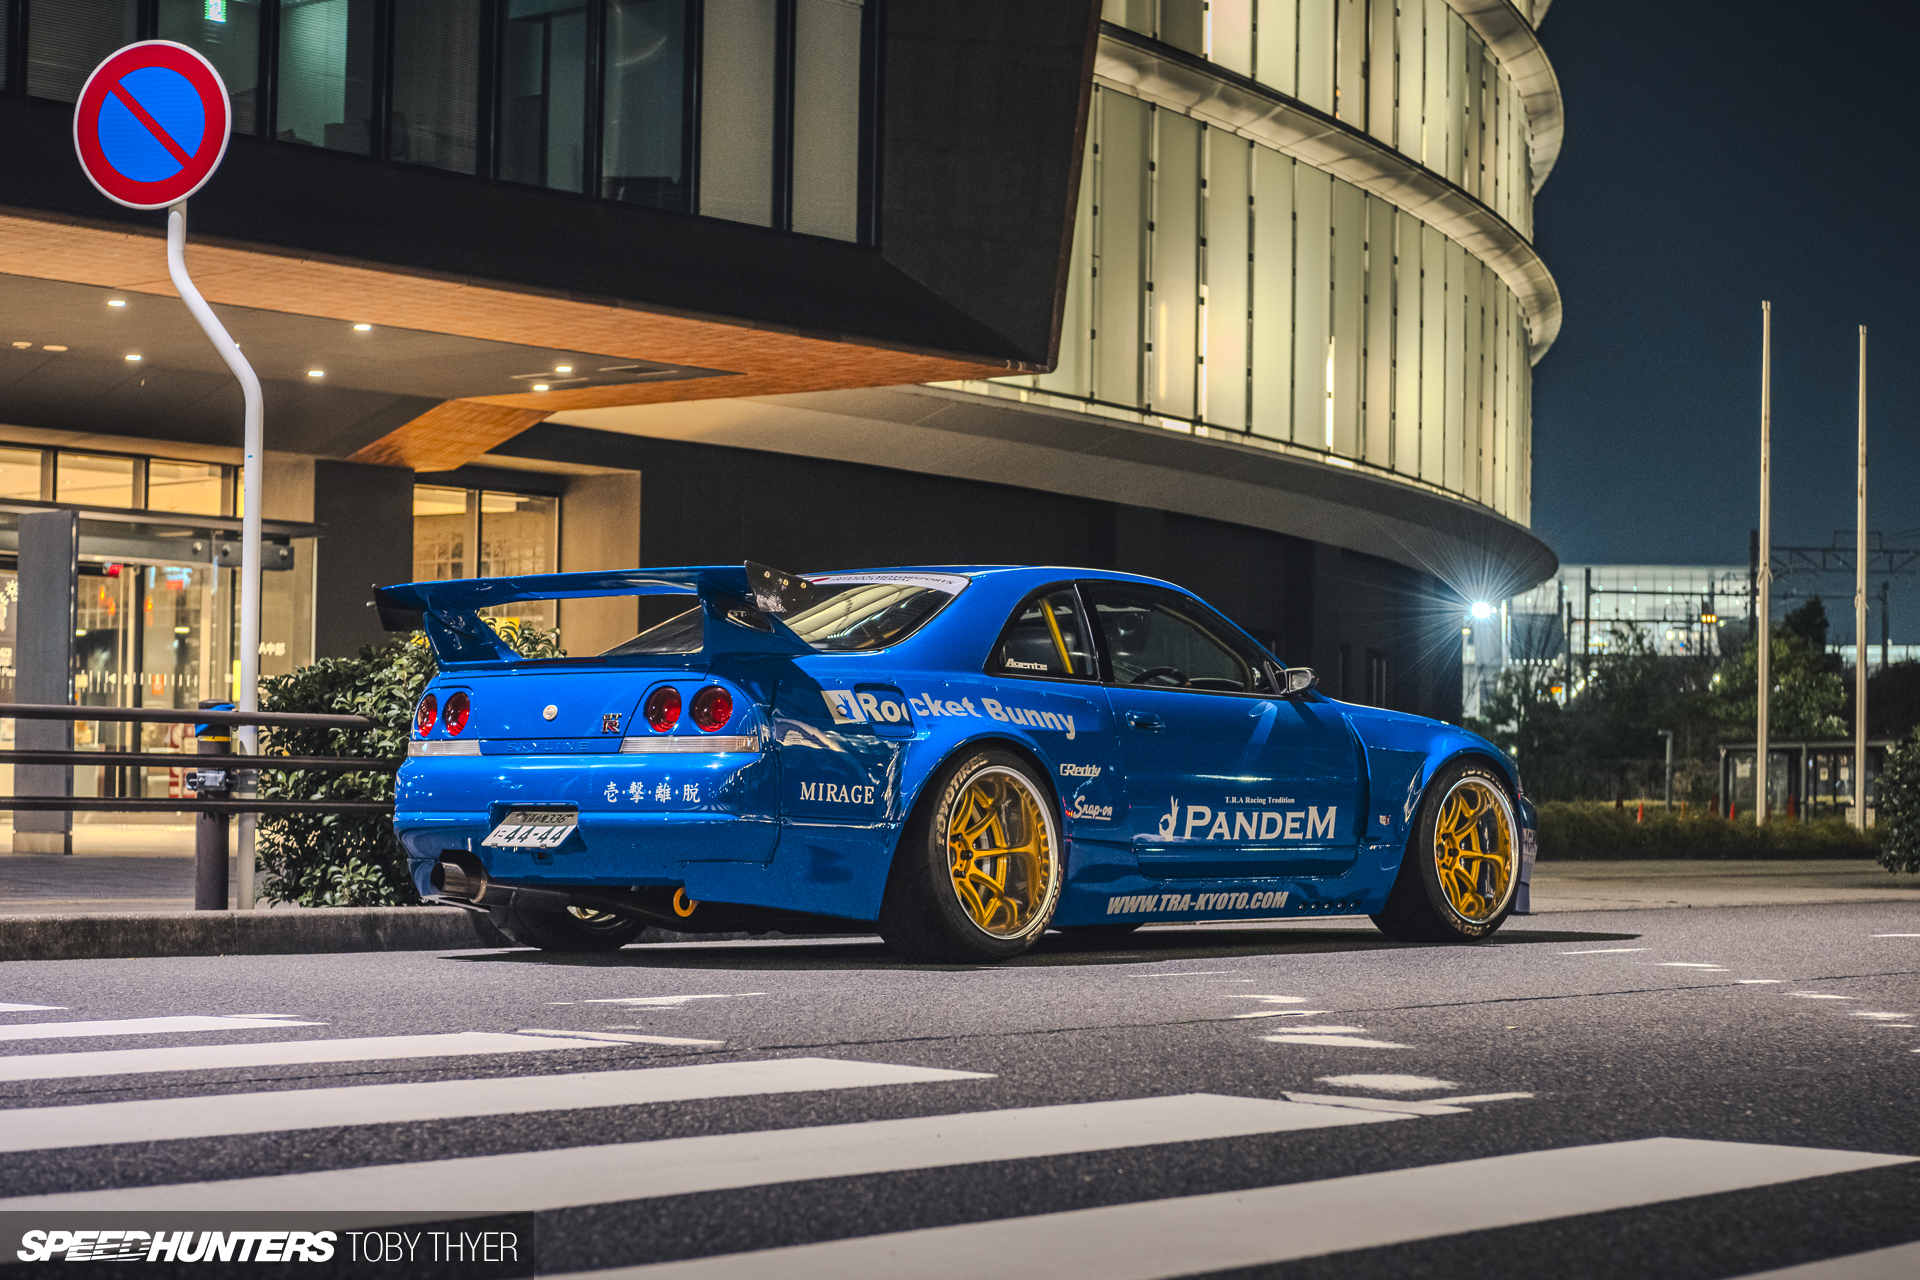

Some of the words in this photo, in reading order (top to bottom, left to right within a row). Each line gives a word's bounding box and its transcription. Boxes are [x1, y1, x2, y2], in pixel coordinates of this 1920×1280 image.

[856, 692, 982, 723] Rocket
[981, 697, 1076, 740] Bunny
[506, 741, 589, 752] SKYLINE
[1060, 764, 1101, 777] GReddy
[800, 782, 875, 805] MIRAGE
[1245, 796, 1267, 805] Racing
[1267, 796, 1295, 804] Tradition
[1073, 795, 1113, 820] Snap-on
[504, 825, 570, 843] 44-44
[1106, 891, 1289, 915] WWW.TRA-KYOTO.COM
